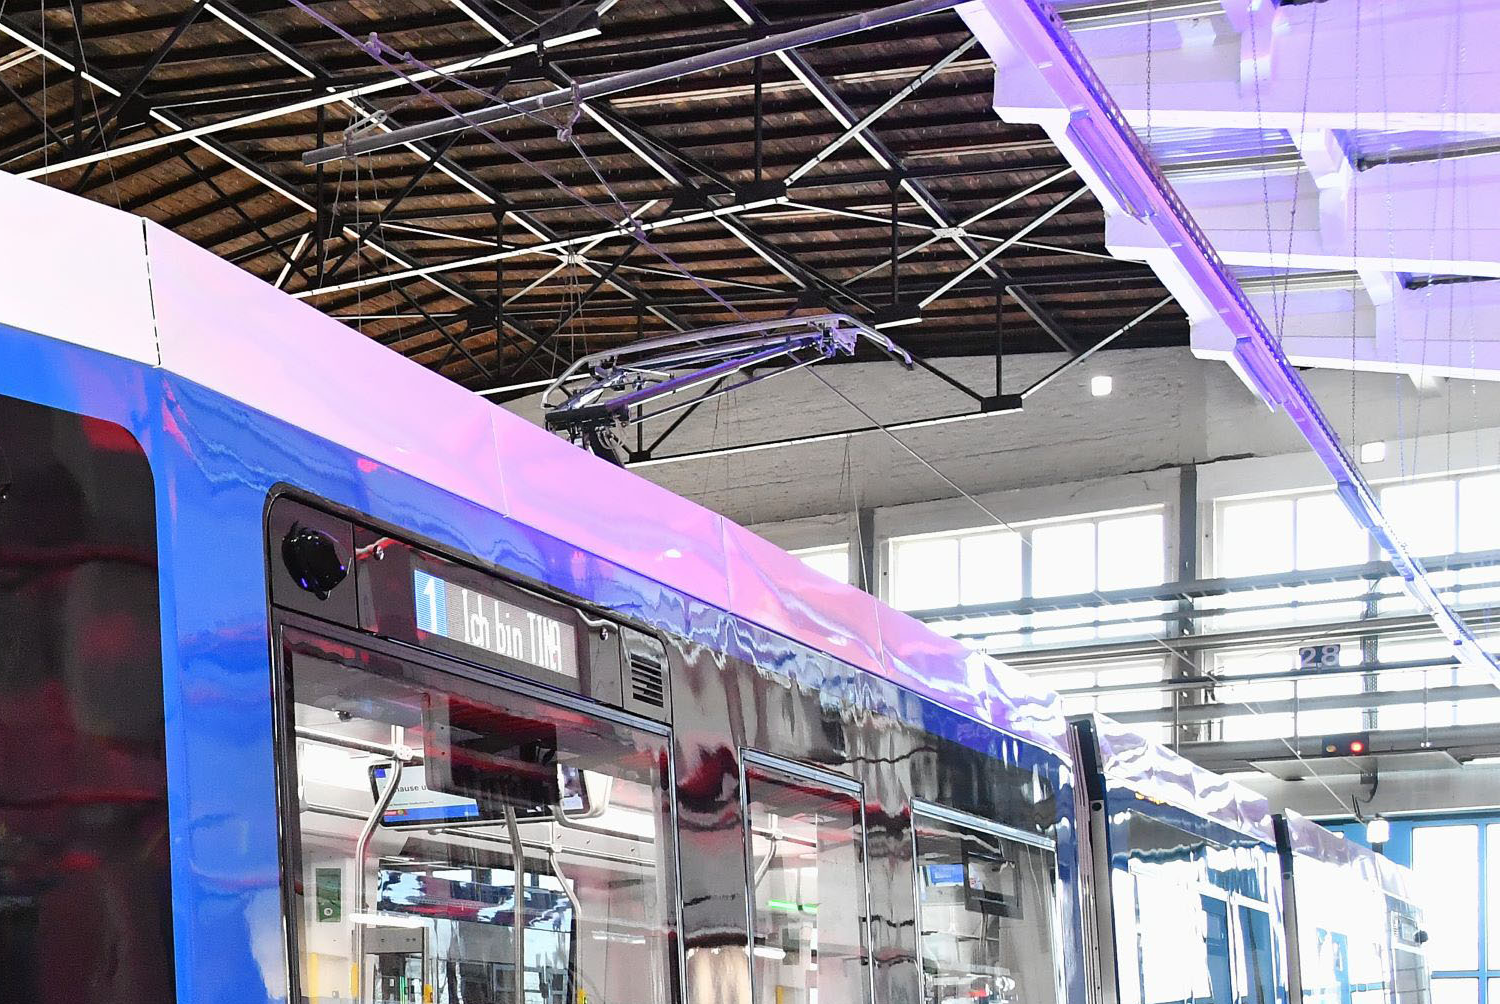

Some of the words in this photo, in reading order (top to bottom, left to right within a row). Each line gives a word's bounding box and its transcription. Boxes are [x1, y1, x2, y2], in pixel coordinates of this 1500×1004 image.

[423, 577, 438, 634] 1
[461, 588, 491, 649] Ich
[494, 600, 523, 660] bin
[527, 612, 562, 672] TINA
[1300, 645, 1340, 668] 28
